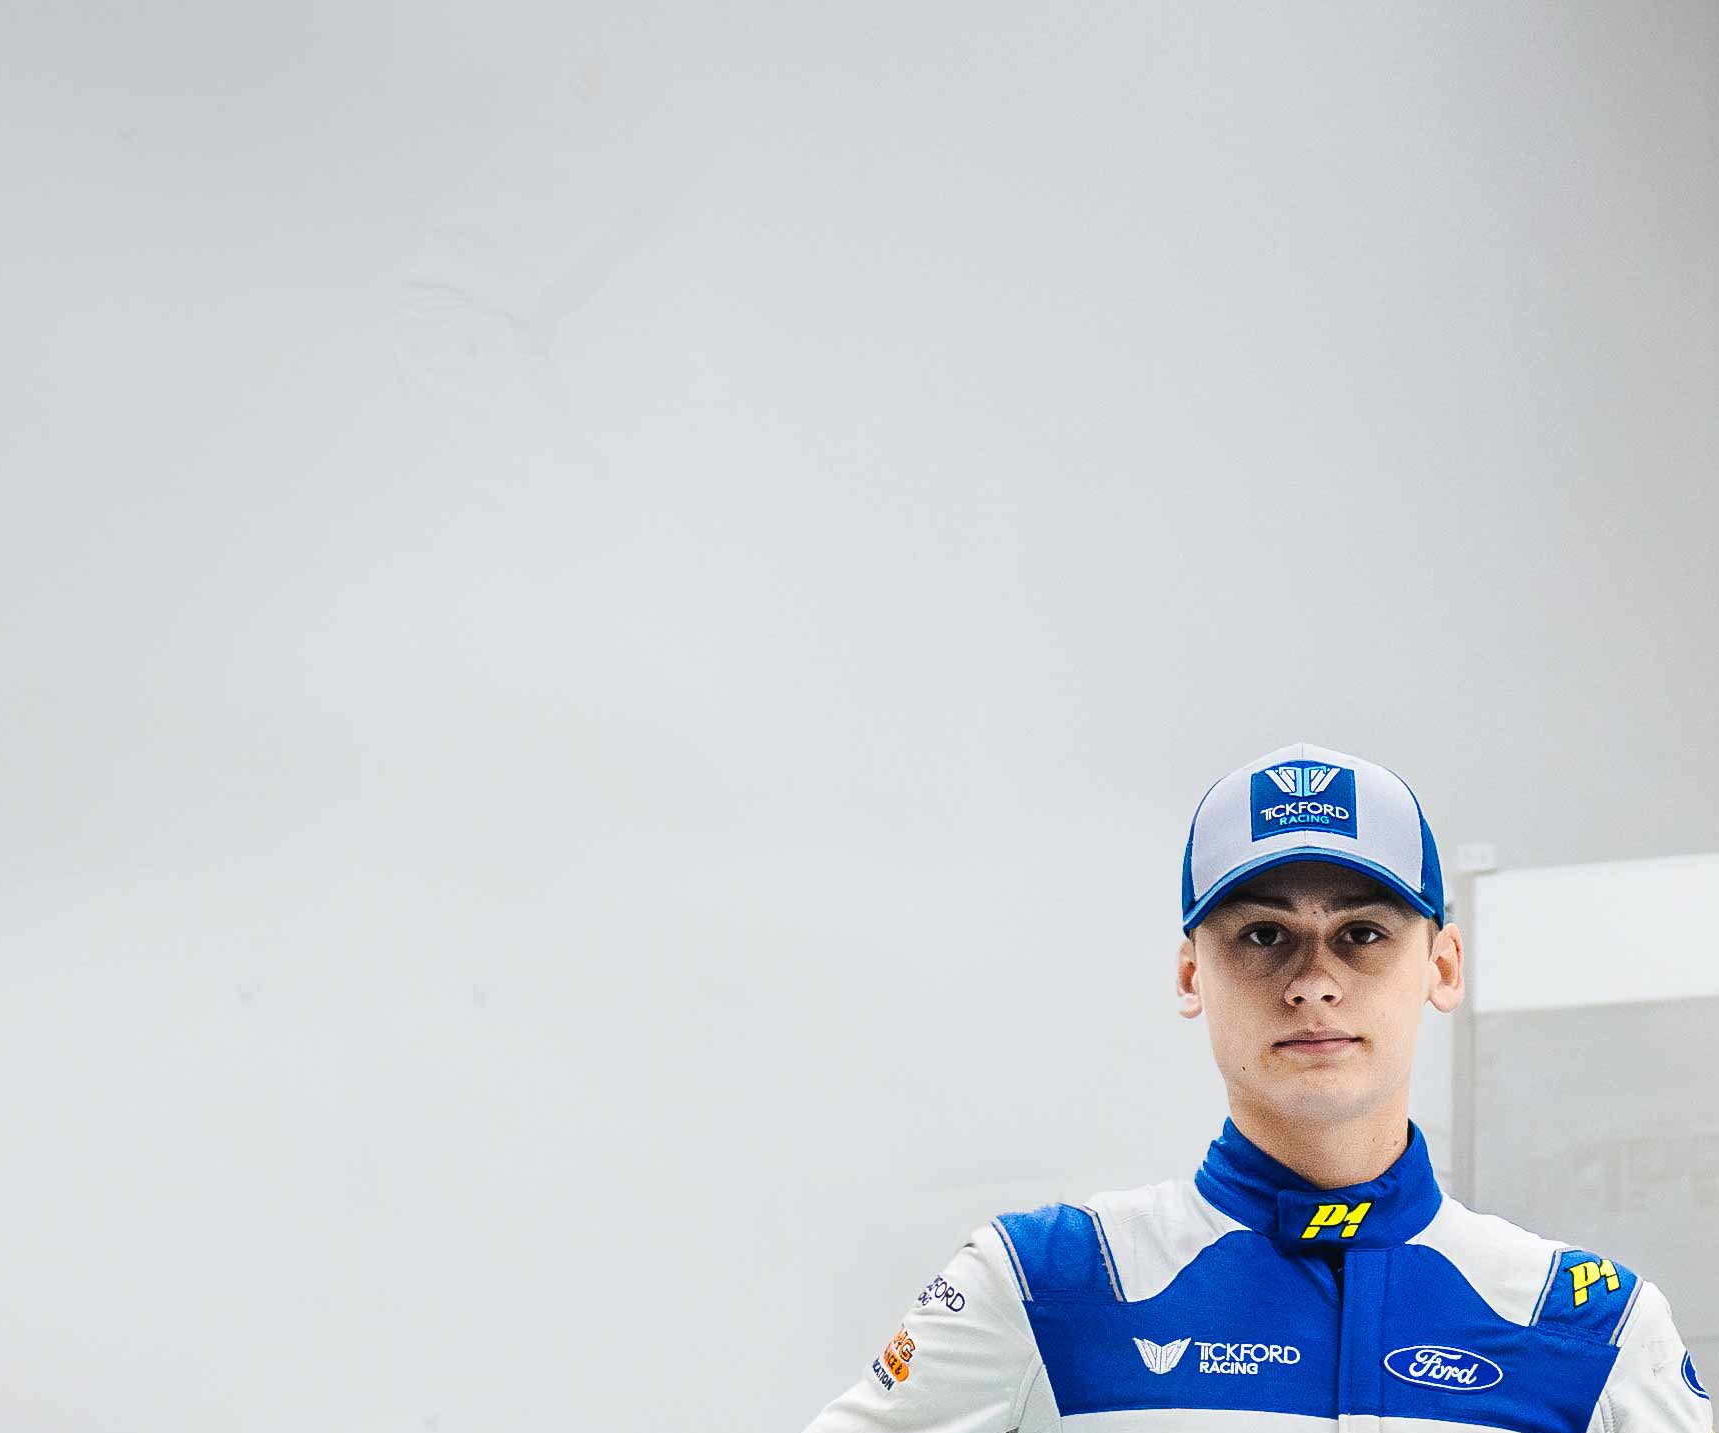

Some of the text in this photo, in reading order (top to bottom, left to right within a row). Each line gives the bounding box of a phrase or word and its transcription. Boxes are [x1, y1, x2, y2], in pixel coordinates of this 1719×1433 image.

[1260, 801, 1350, 822] TICKFORD
[1279, 814, 1330, 826] RACING
[1302, 1202, 1372, 1240] P1
[1567, 1258, 1621, 1308] P1
[1194, 1341, 1301, 1365] TICKFORD
[1199, 1361, 1259, 1376] RACING
[1408, 1348, 1478, 1385] Ford
